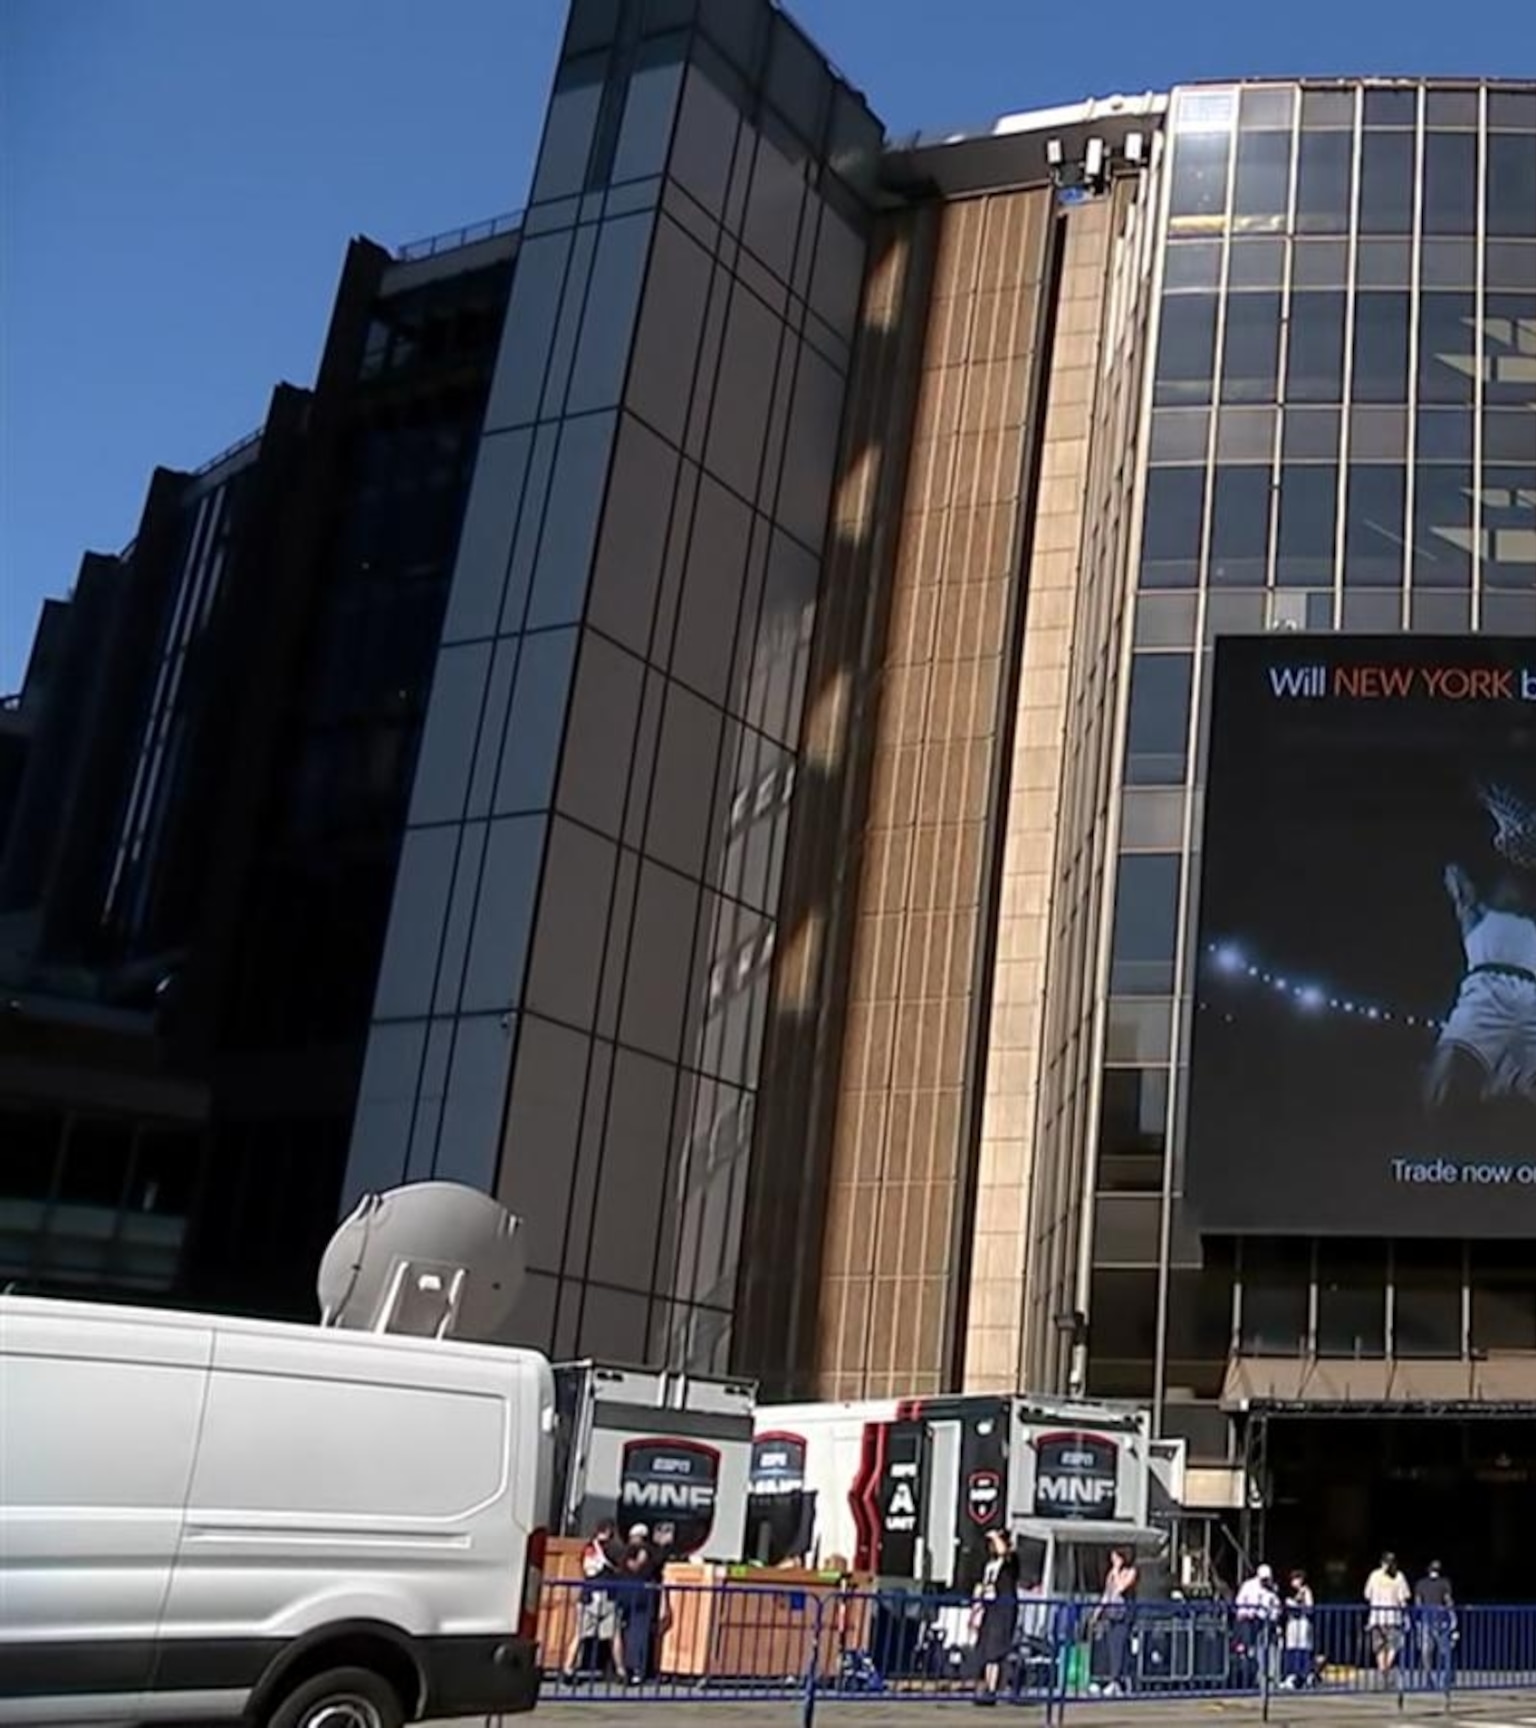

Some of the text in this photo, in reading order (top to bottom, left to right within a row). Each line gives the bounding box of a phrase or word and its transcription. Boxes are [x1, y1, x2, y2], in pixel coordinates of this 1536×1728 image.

[1269, 666, 1327, 697] Will
[1334, 668, 1414, 697] NEW
[1421, 669, 1513, 699] YORK
[1391, 1158, 1457, 1183] Trade
[1461, 1164, 1512, 1184] now
[652, 1457, 692, 1473] ESPN
[1061, 1451, 1095, 1466] ESPN
[624, 1481, 714, 1509] MNF
[889, 1482, 916, 1513] A
[1038, 1476, 1115, 1502] MNF
